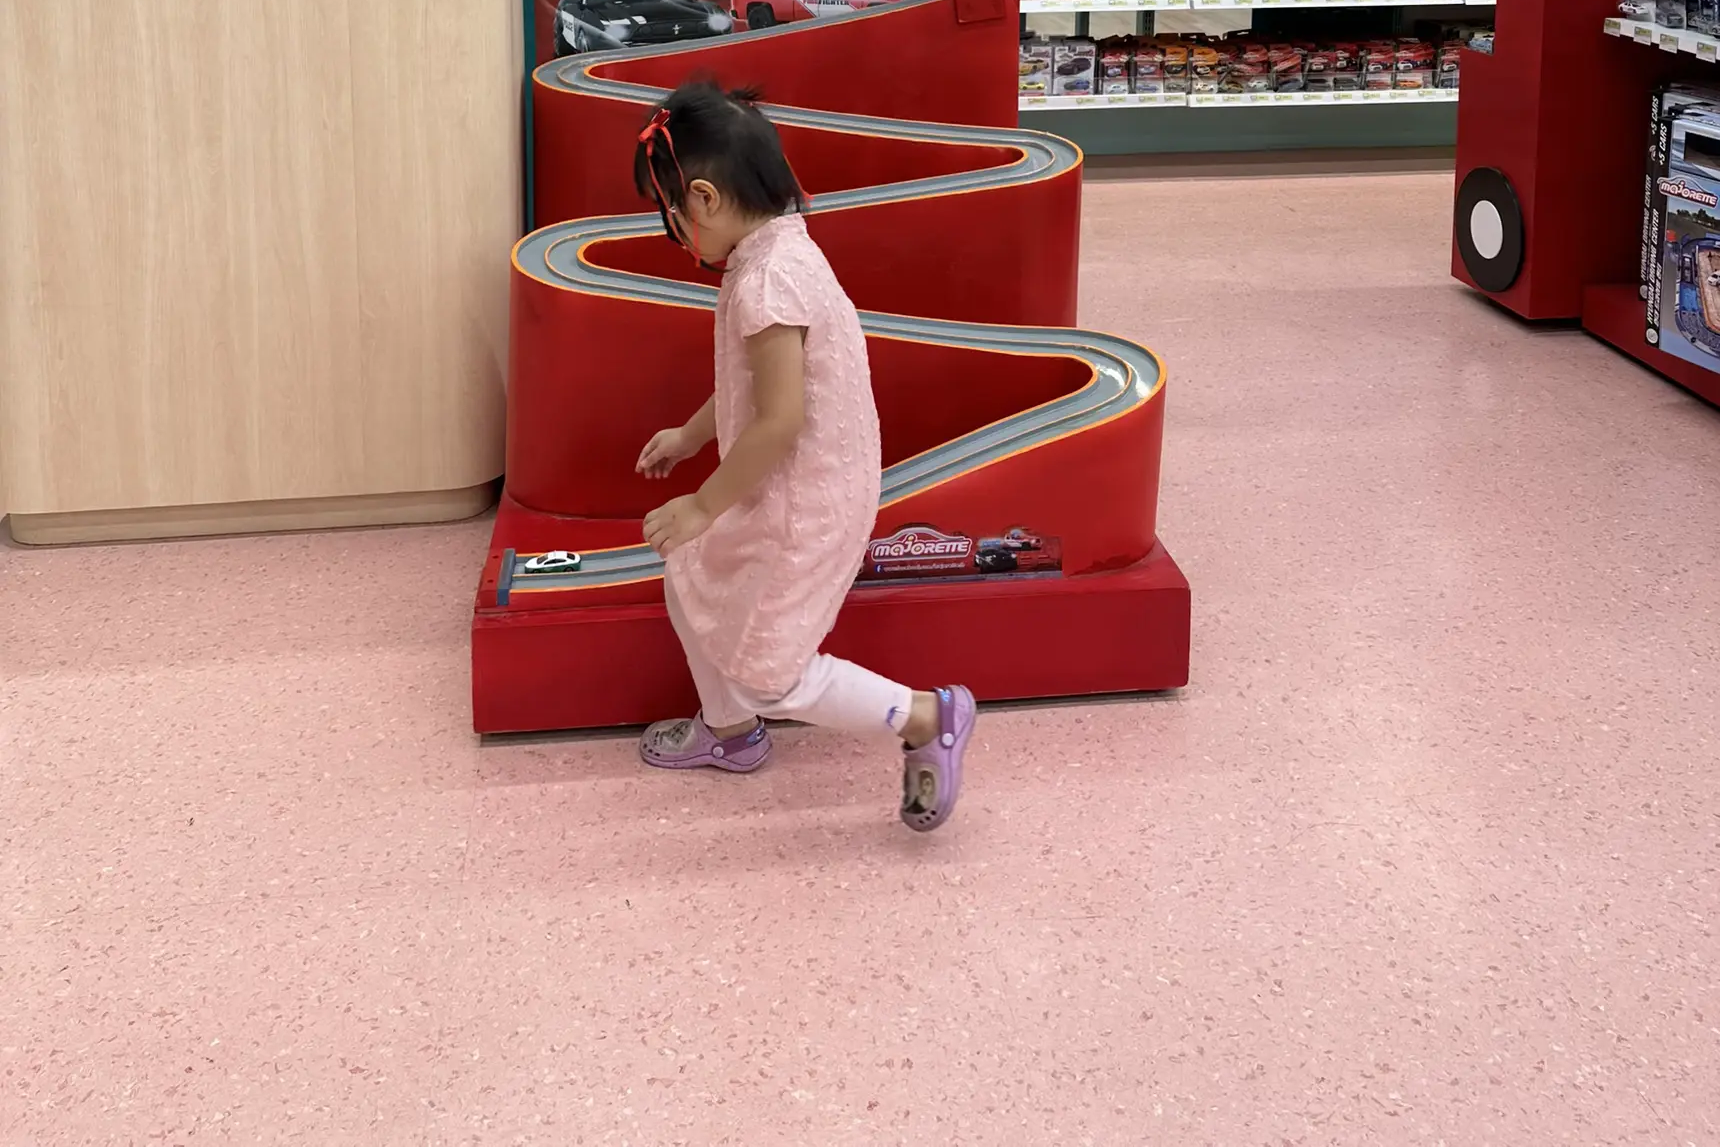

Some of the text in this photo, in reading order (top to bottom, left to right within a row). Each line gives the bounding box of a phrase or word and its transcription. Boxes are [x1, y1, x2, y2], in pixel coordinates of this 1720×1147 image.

[1659, 123, 1667, 151] CARS
[1651, 208, 1659, 245] CENTER
[1649, 245, 1657, 283] DRIVING
